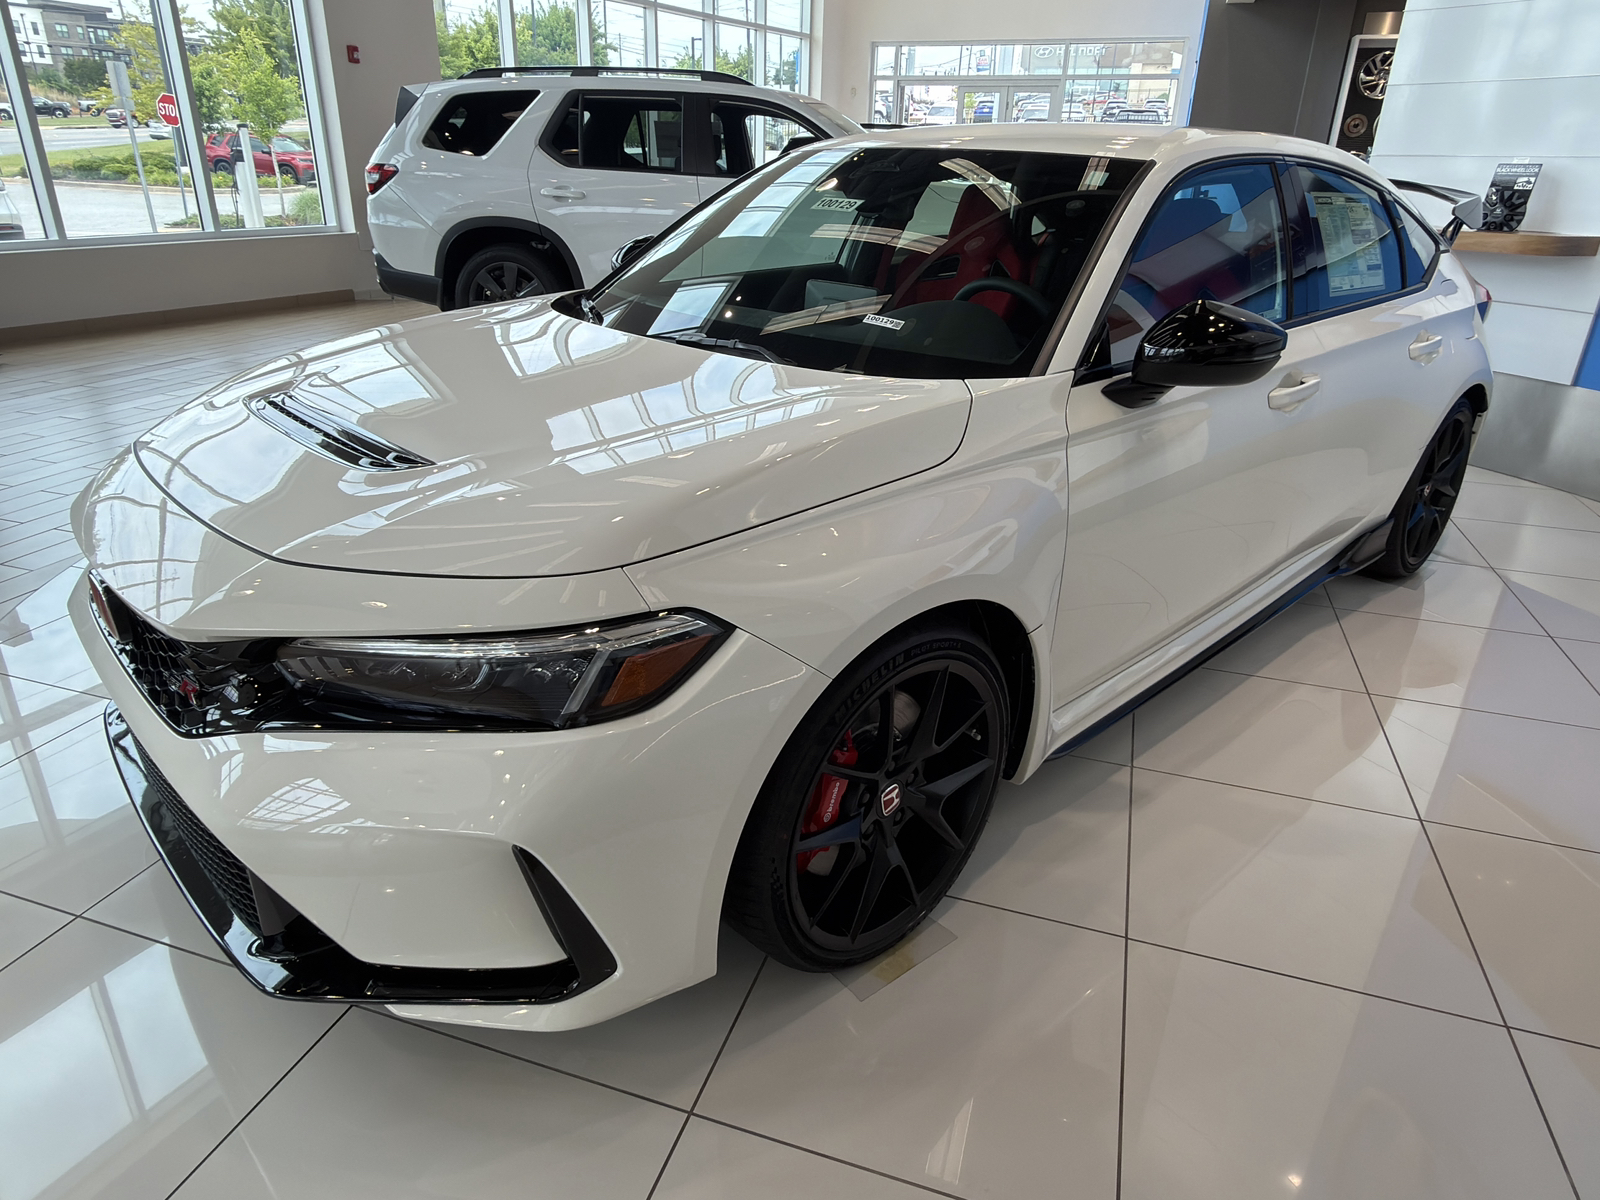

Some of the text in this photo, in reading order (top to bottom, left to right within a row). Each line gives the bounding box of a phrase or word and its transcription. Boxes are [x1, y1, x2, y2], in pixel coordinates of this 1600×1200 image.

[1056, 46, 1106, 56] HUNDAI
[159, 102, 178, 117] STO
[817, 198, 858, 210] 100129
[866, 315, 895, 325] 100129
[834, 652, 906, 724] MICHELIN
[910, 643, 931, 657] PILOT
[932, 641, 953, 649] SPORT
[826, 781, 840, 812] brembo
